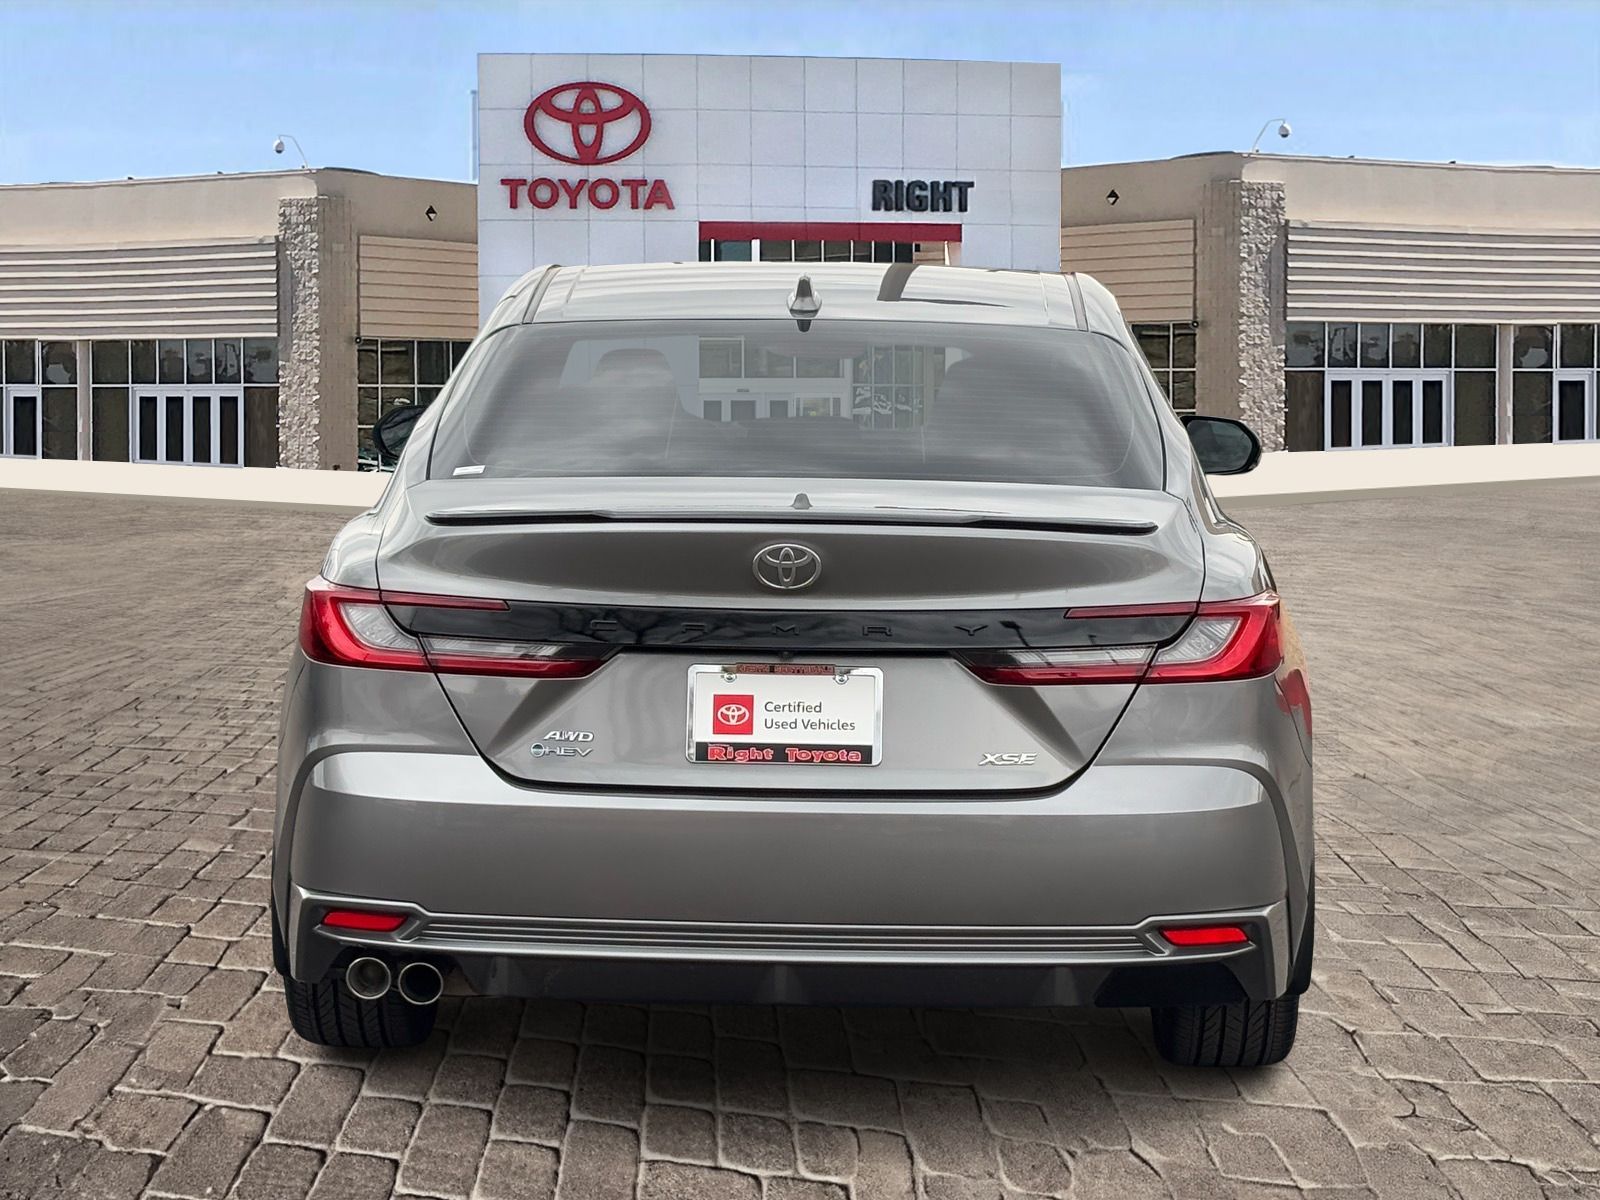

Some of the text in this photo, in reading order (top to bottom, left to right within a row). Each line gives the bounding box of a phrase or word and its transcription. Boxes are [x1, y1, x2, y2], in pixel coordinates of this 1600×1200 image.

[500, 178, 675, 210] TOYOTA
[871, 178, 975, 213] RIGHT
[764, 701, 823, 714] Certified
[764, 718, 856, 731] Used Vehicles
[543, 730, 594, 742] AWD
[544, 746, 593, 758] HEV
[707, 745, 862, 763] Right Toyota
[978, 752, 1038, 766] XSE
